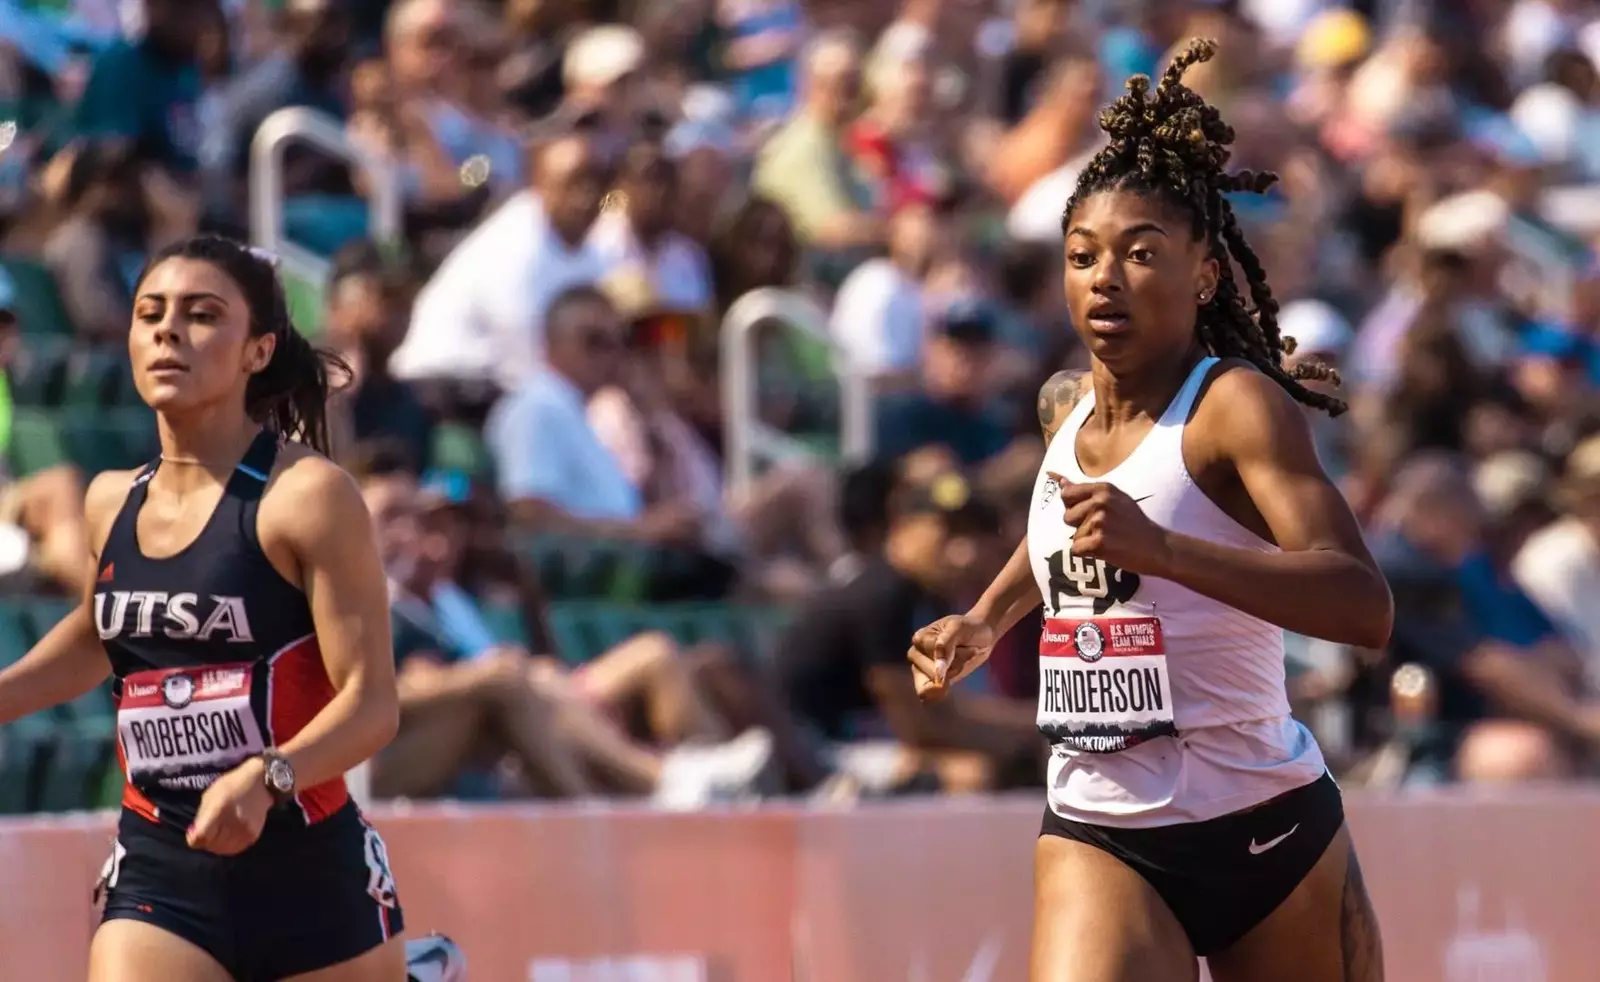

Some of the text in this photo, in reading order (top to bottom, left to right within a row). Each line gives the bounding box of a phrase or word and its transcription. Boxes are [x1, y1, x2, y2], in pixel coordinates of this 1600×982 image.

[94, 590, 255, 643] UTSA
[1124, 623, 1155, 636] OLYMPIC
[1111, 635, 1156, 648] TEAM TRIALS
[1045, 667, 1163, 713] HENDERSON
[130, 708, 248, 760] ROBERSON
